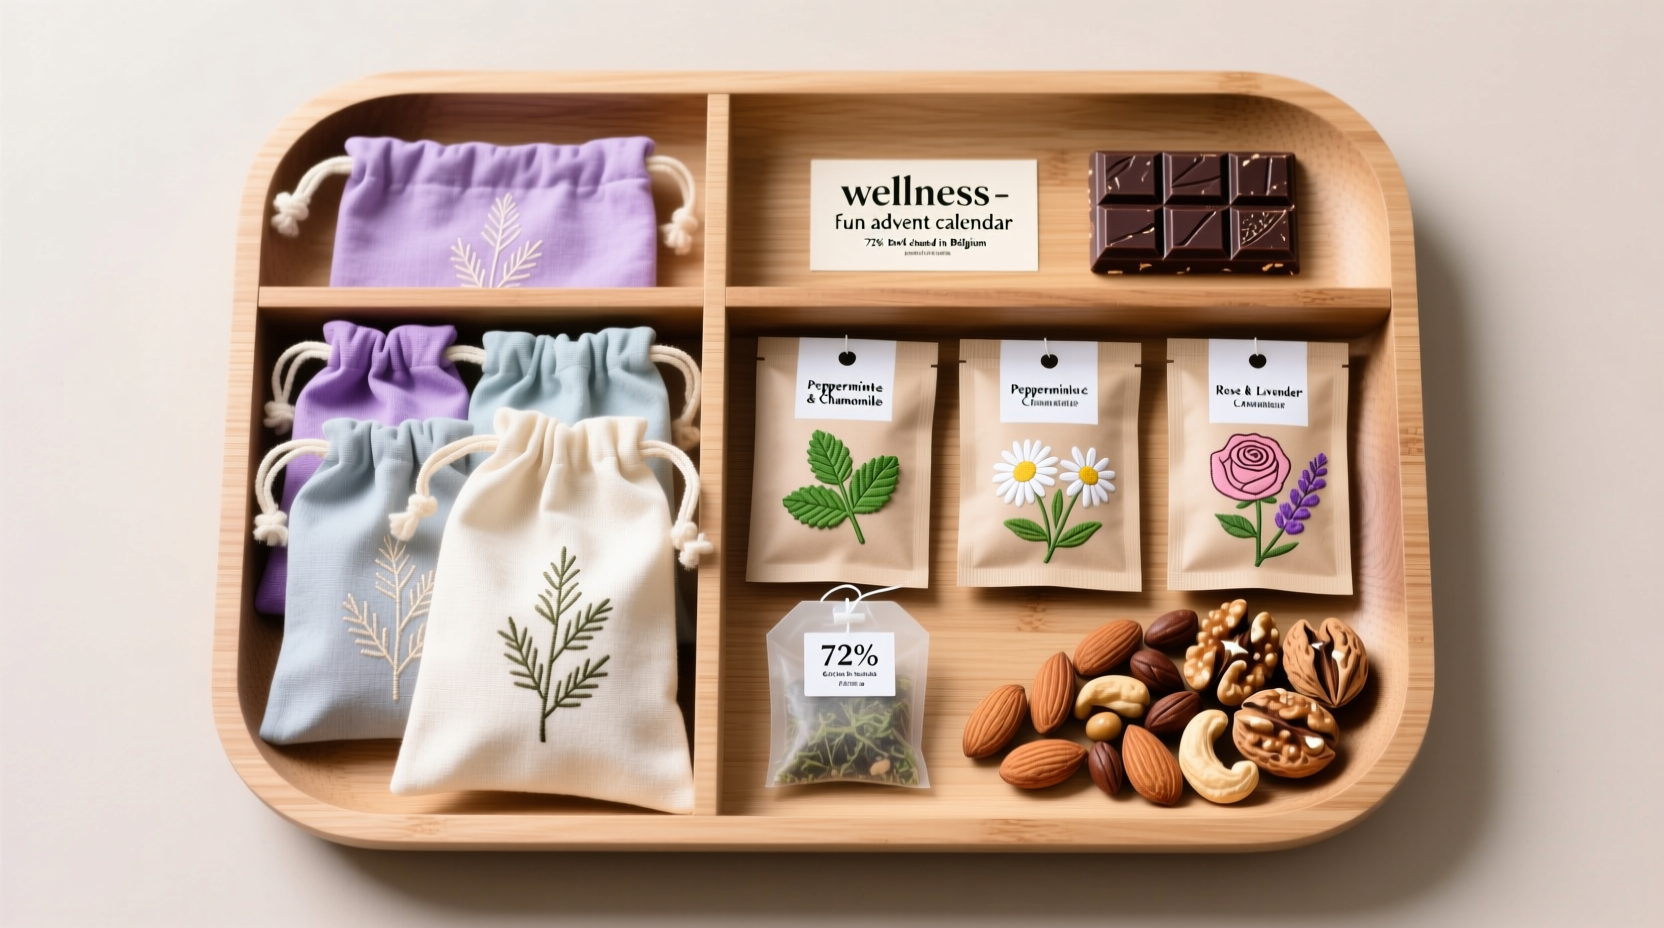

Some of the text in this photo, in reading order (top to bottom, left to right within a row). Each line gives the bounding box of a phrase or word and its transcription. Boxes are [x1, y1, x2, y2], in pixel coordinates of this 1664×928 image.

[871, 213, 931, 230] advent
[935, 213, 1013, 230] calendar
[939, 238, 947, 247] in
[807, 394, 883, 406] & Chamomile
[821, 644, 878, 666] 72%
